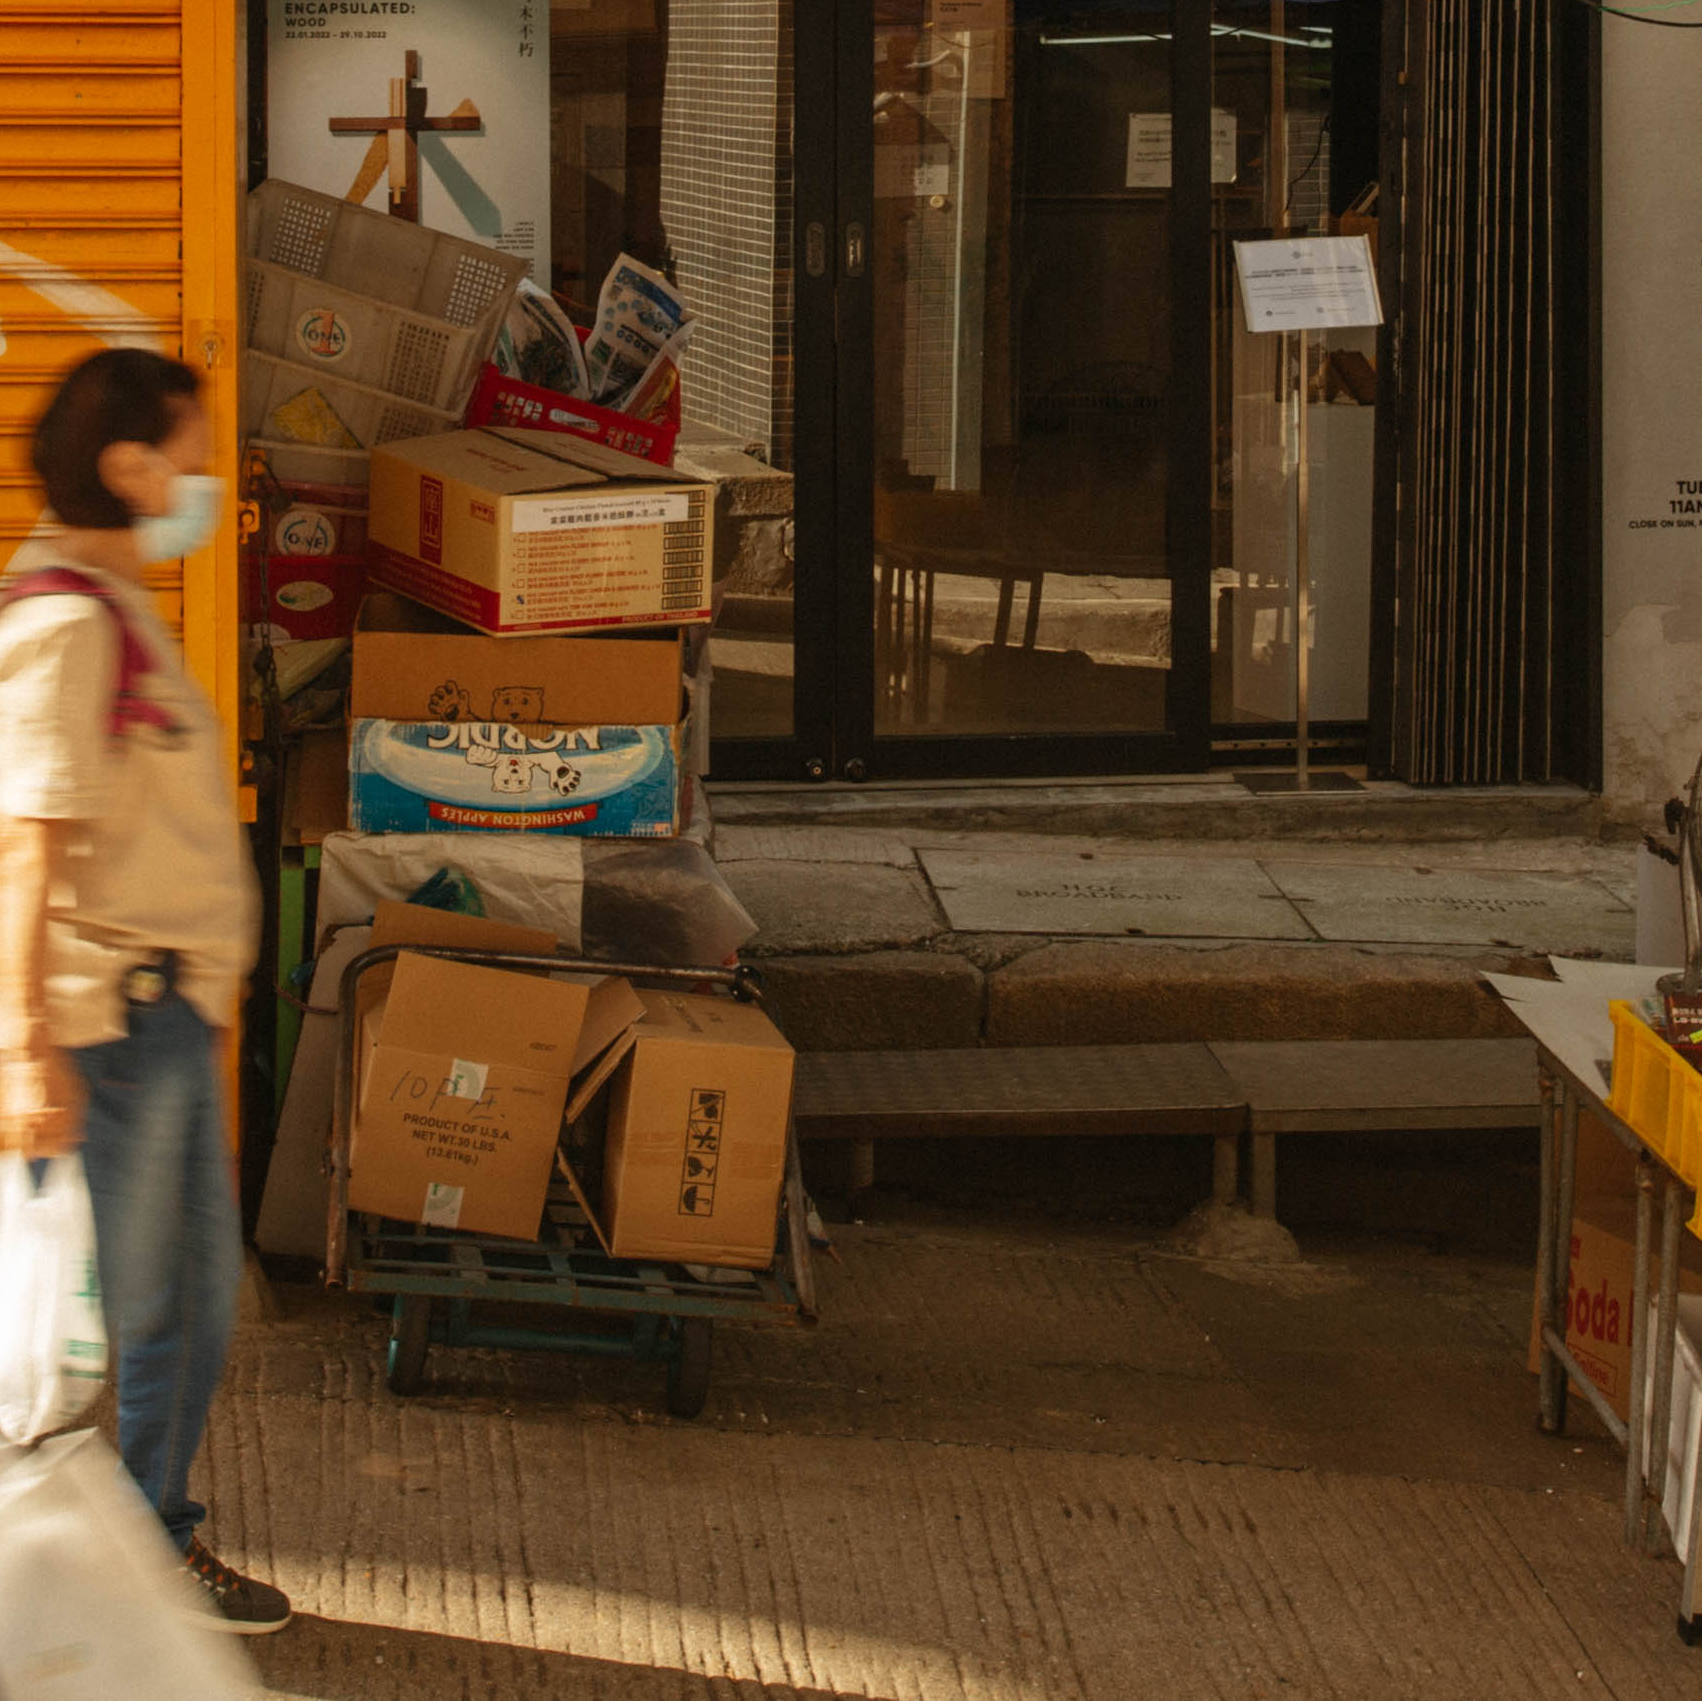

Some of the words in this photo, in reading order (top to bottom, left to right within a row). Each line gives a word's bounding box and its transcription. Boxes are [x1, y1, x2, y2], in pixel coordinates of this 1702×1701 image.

[284, 2, 416, 15] ENCAPSULATED:
[285, 18, 326, 27] WOOD
[1628, 520, 1658, 529] CLOSE
[1660, 520, 1675, 528] ON
[1676, 519, 1697, 529] SUN,
[439, 806, 488, 825] APPLES
[492, 809, 586, 827] WASHINGTON
[402, 1113, 460, 1132] PRODUCT
[461, 1123, 477, 1134] OF
[480, 1126, 513, 1142] U.S.A.
[411, 1129, 435, 1142] NET
